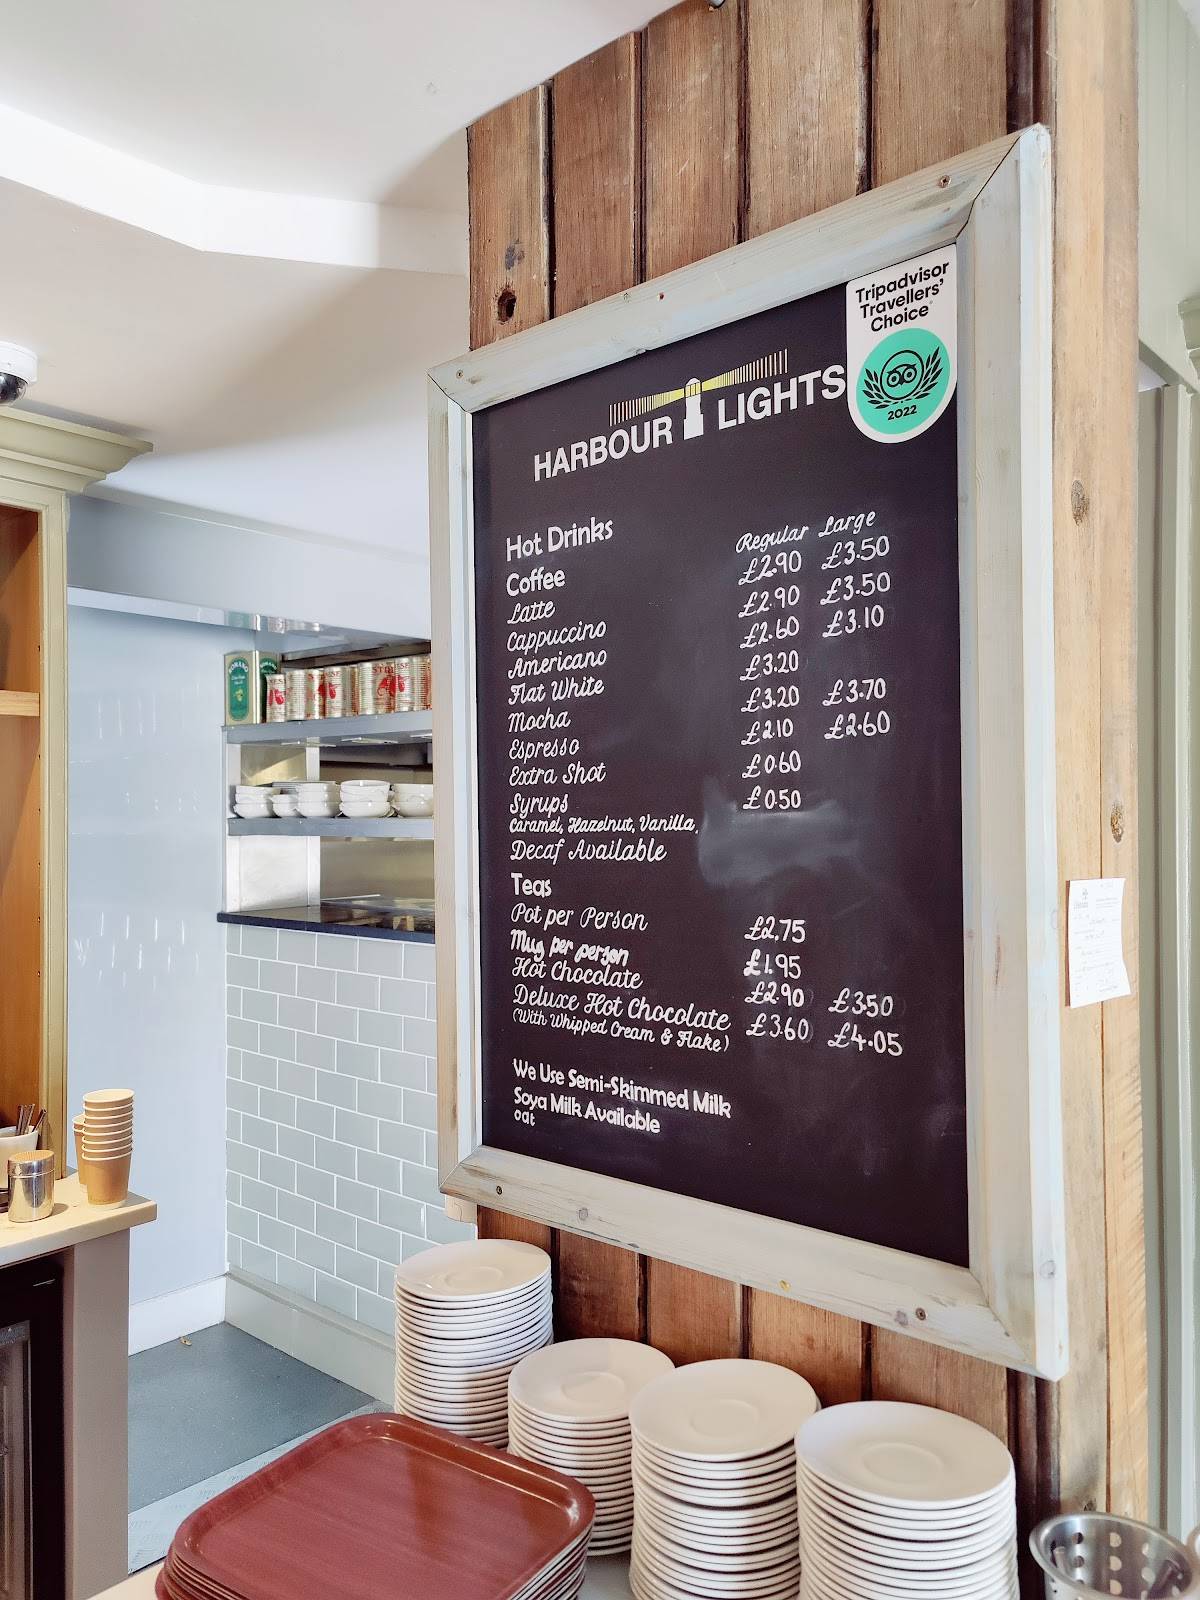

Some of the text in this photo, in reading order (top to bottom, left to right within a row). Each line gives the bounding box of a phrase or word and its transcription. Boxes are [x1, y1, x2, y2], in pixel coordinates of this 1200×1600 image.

[856, 261, 949, 303] Tripadvisor
[860, 278, 944, 319] Travellers'
[871, 305, 929, 332] Choice
[533, 364, 846, 483] HARBOUR LIGHTS
[887, 404, 917, 421] 2022
[506, 516, 614, 562] Hot Drinks
[735, 511, 876, 553] Regular Large
[738, 535, 890, 585] £2.90 £3.50
[506, 566, 566, 597] Coffee
[738, 571, 891, 618] £2.90 £3.50
[507, 600, 556, 624] Latte
[739, 604, 885, 649] £2.60 £3.10
[507, 621, 606, 655] Cappuccino
[507, 650, 607, 680] Americano
[739, 650, 799, 681] £3.20
[508, 676, 605, 705] Flat White
[740, 677, 887, 712] £3.20 £3.70
[508, 707, 571, 733] Mocha
[740, 710, 891, 745] £2.10 £2.60
[509, 737, 580, 764] Espresso
[741, 750, 801, 778] £0.60
[509, 761, 607, 786] Extra Shot
[509, 793, 569, 819] Syrups
[742, 785, 801, 810] £0.50
[509, 814, 699, 835] Caramel, Hazelnut, Vanilla,
[510, 838, 667, 865] Decaf Available
[510, 872, 552, 898] Teas
[511, 902, 648, 931] Pot per Person
[744, 915, 806, 943] £2.75
[510, 929, 629, 966] Mug per person
[511, 956, 643, 989] Hot Chocolate
[743, 948, 801, 979] £1.95
[513, 983, 732, 1031] Deluxe Hot Chocolate
[744, 981, 894, 1018] £2.90 £3.50
[512, 1008, 730, 1052] (With Whipped Cream & Flake)
[745, 1012, 903, 1057] £3.60 £4.05
[512, 1058, 732, 1119] We Use Semi-Skimmed Milk
[513, 1086, 661, 1134] Soya Milk Available
[513, 1109, 536, 1127] oat
